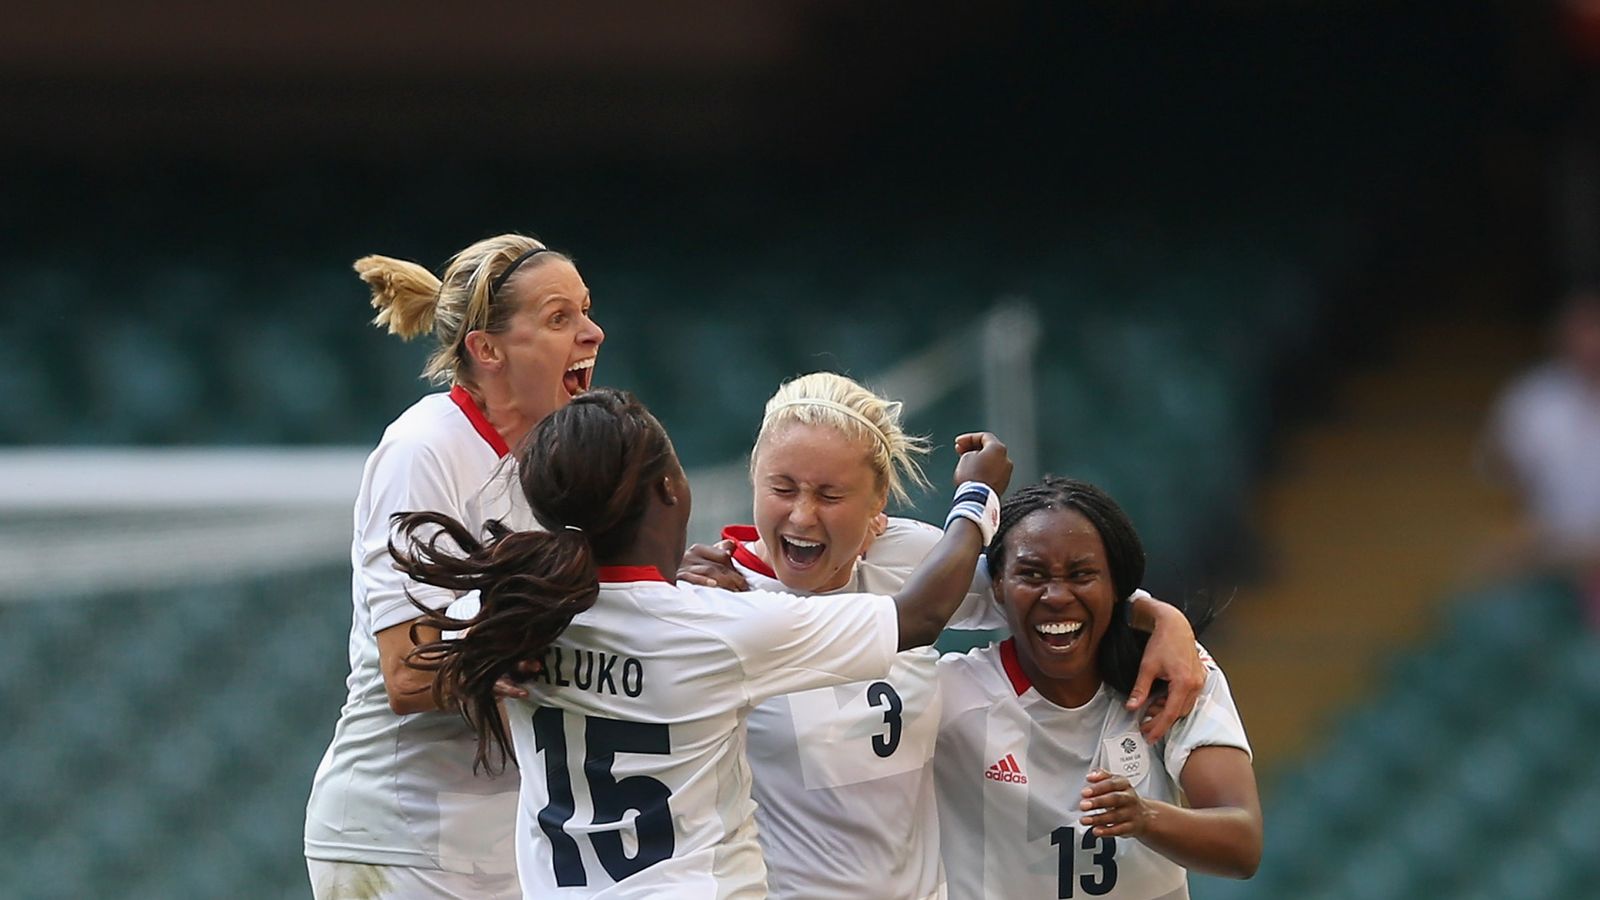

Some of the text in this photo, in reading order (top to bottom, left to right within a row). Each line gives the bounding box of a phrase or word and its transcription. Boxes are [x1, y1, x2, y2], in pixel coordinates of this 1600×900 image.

[866, 681, 902, 757] 3
[532, 705, 675, 888] 15
[985, 769, 1027, 784] adidas
[1050, 826, 1118, 899] 13
